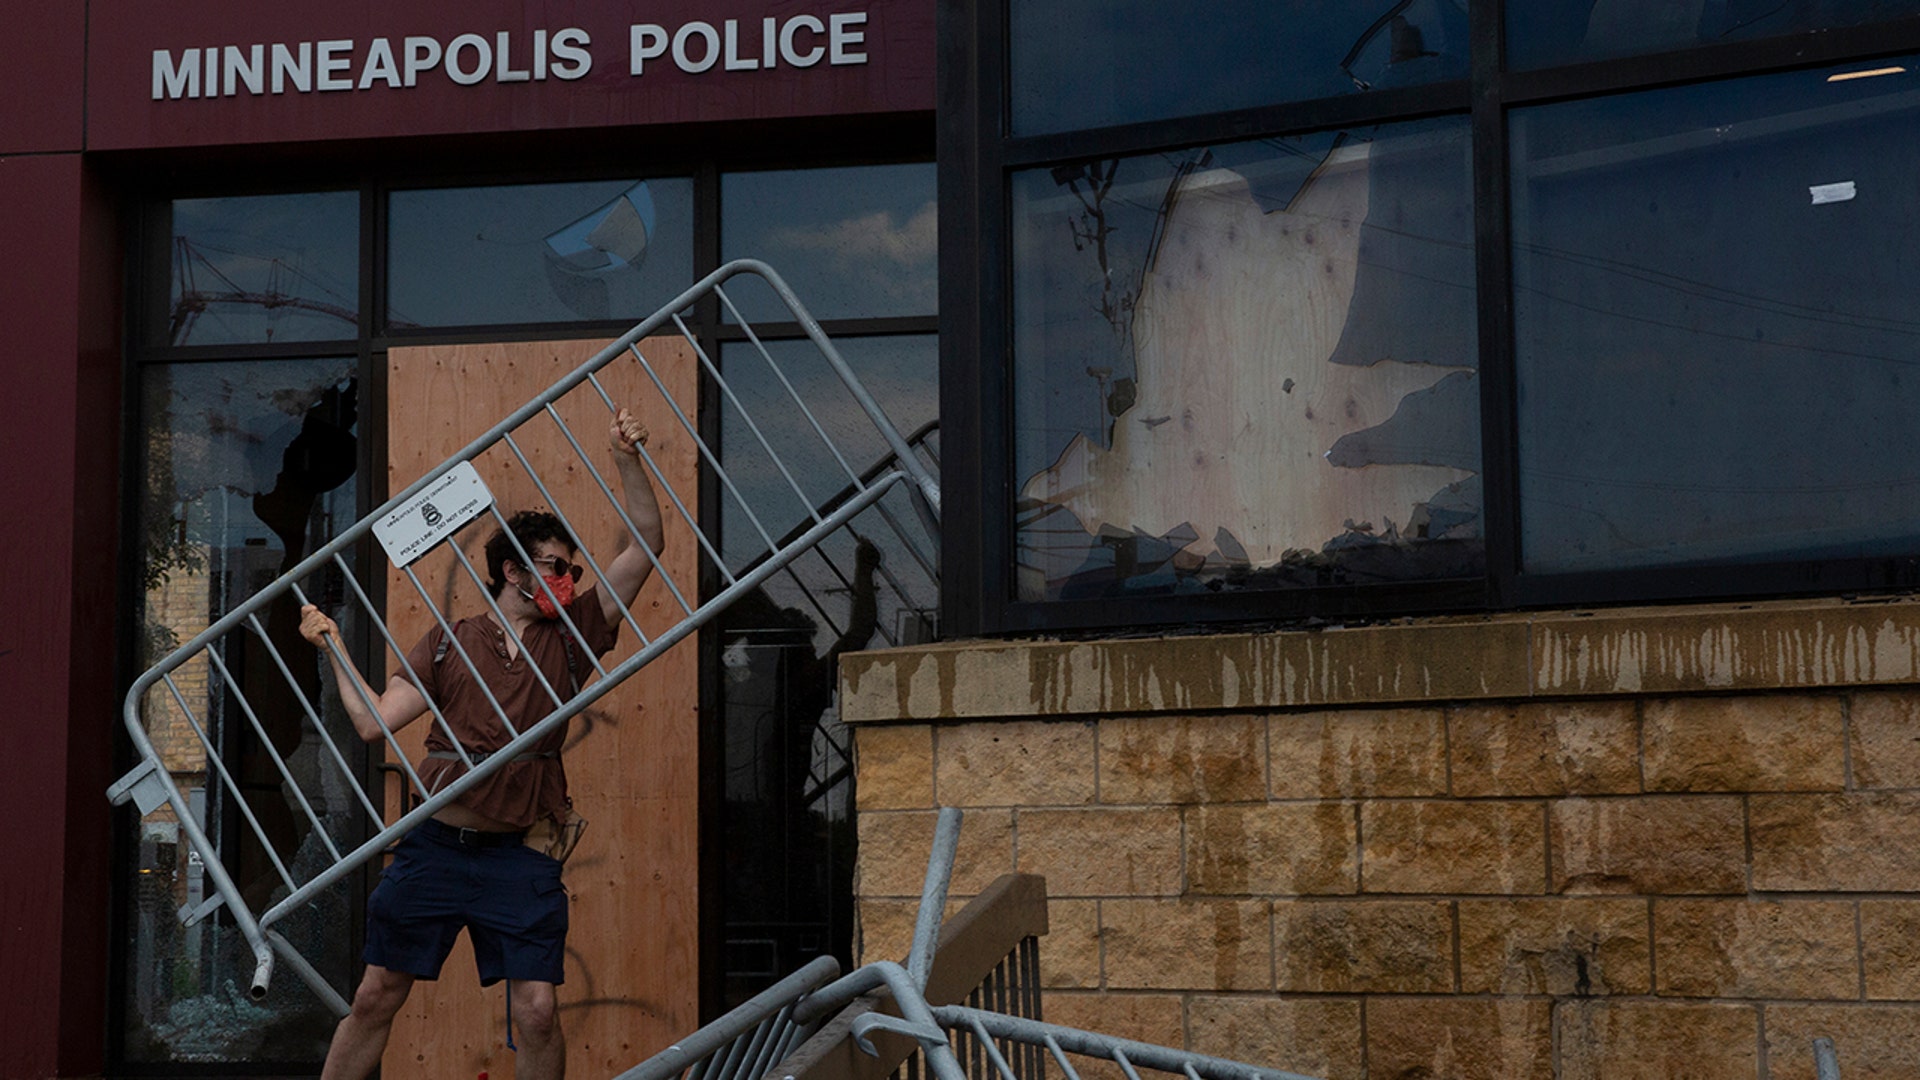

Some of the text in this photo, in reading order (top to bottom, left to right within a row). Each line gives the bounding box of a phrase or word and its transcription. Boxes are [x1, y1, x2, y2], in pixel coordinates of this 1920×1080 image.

[151, 12, 868, 100] MINNEAPOLIS POLICE
[400, 541, 420, 556] POLICE
[420, 532, 433, 542] LINE
[437, 522, 446, 530] DO
[446, 513, 458, 523] NOT
[459, 499, 478, 514] CROSS
